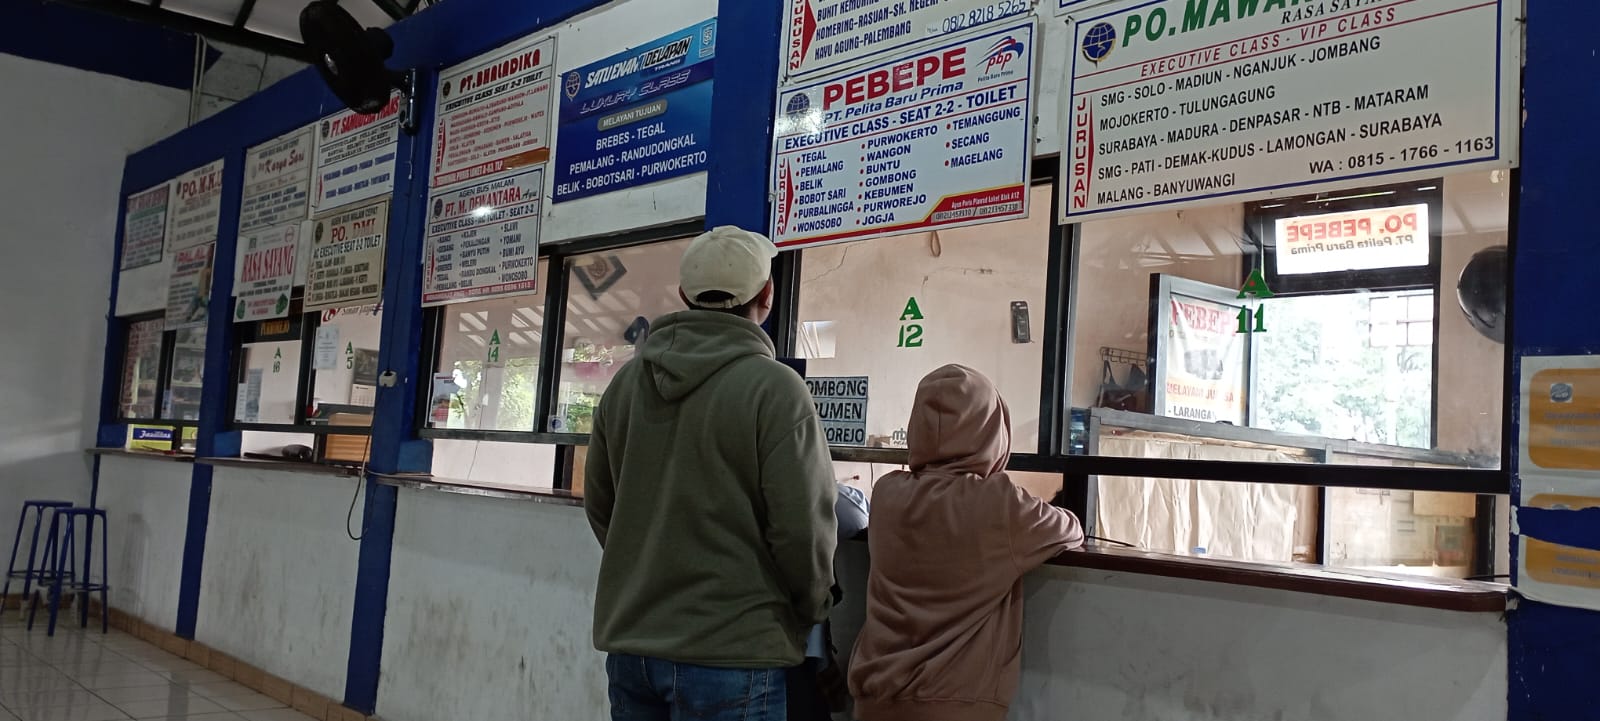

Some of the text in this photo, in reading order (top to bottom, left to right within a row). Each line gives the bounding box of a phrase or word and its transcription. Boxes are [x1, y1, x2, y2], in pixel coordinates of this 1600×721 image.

[942, 13, 965, 32] 0812
[968, 5, 994, 26] 8218
[1281, 2, 1325, 24] RASA
[1141, 8, 1394, 76] EXECUTIVE CLASS VIP CLASS
[985, 48, 1012, 74] pbp
[1101, 36, 1380, 106] SMG SOLO MADIUN NGANJUK JOMBANG
[823, 48, 966, 110] PEBEPE
[474, 88, 493, 101] CLASS
[824, 80, 964, 122] PT. Pelita Baru Prima
[603, 103, 662, 127] MELAYANI TUJUAN
[785, 85, 1016, 150] EXECUTIVE CLASS SEAT 2-2 TOILET
[953, 106, 1020, 131] TEMANGGUNG
[1099, 84, 1428, 156] SURABAYA MADURA DENPASAR NTB MATARAM
[1100, 86, 1276, 132] MOJOKERTO TULUNGAGUNG
[596, 122, 666, 150] BREBES TEGAL
[868, 125, 938, 149] PURWOKERTO
[952, 132, 990, 150] SECANG
[1098, 113, 1442, 180] SMG PATI DEMAK-KUDUS LAMONGAN SURABAYA
[570, 134, 696, 175] PEMALANG RANDUDONGKAL
[802, 150, 827, 164] TEGAL
[867, 144, 912, 162] WANGON
[950, 148, 1003, 168] MAGELANG
[1074, 98, 1087, 208] JURUSAN
[1310, 136, 1494, 174] WA 0815 1766 1163
[557, 150, 706, 196] BELIK BOBOTSARI PURWOKERTO
[800, 160, 844, 177] PEMALANG
[866, 160, 900, 174] BUNTU
[866, 169, 917, 187] GOMBONG
[460, 178, 514, 198] AGEN BUS MALAM
[799, 188, 846, 205] BOBOT SARI
[800, 178, 824, 191] BELIK
[864, 182, 914, 200] KEBUMEN
[1098, 173, 1235, 205] MALANG BANYUWANGI
[445, 202, 456, 216] PT.
[776, 158, 786, 236] JURUSAN
[864, 194, 926, 212] PURWOREJO
[432, 220, 458, 234] EXECUTIVE
[458, 216, 474, 228] CLASS
[510, 206, 524, 217] SEAT
[526, 204, 534, 214] 2-2
[798, 201, 854, 218] PURBALINGGA
[862, 212, 895, 226] JOGJA
[331, 226, 348, 244] PO.
[798, 216, 842, 232] WONOSOBO
[1236, 269, 1274, 298] A
[900, 296, 924, 320] A
[1171, 300, 1234, 337] PEBEP
[1236, 304, 1267, 333] 11
[345, 341, 354, 354] A
[489, 328, 500, 346] A
[896, 324, 923, 348] 12
[274, 346, 282, 359] A
[488, 346, 499, 363] 14
[1168, 406, 1211, 420] LARANGA
[824, 428, 864, 442] OREJO
